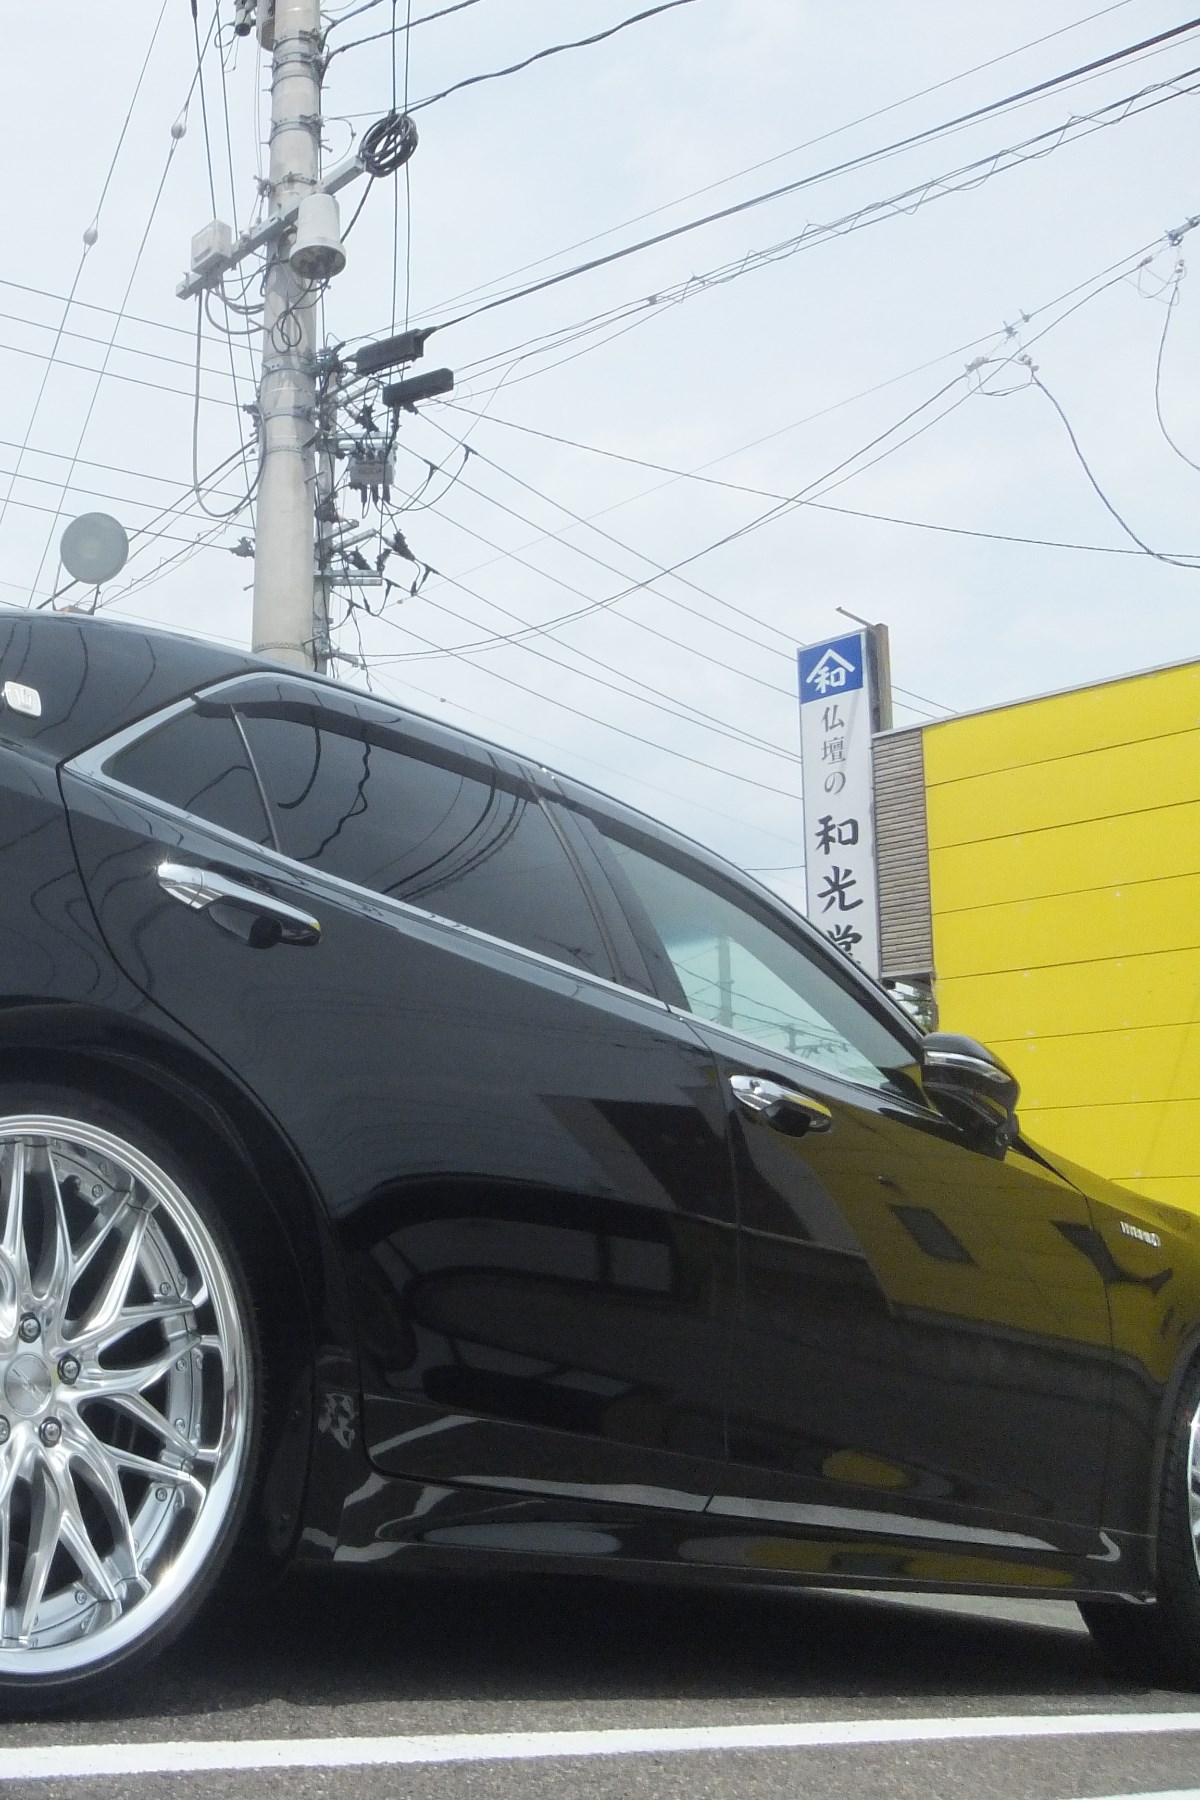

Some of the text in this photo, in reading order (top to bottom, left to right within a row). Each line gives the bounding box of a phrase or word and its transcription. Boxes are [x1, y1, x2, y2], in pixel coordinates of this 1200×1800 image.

[814, 666, 846, 694] 和
[820, 704, 847, 795] 仏壇の
